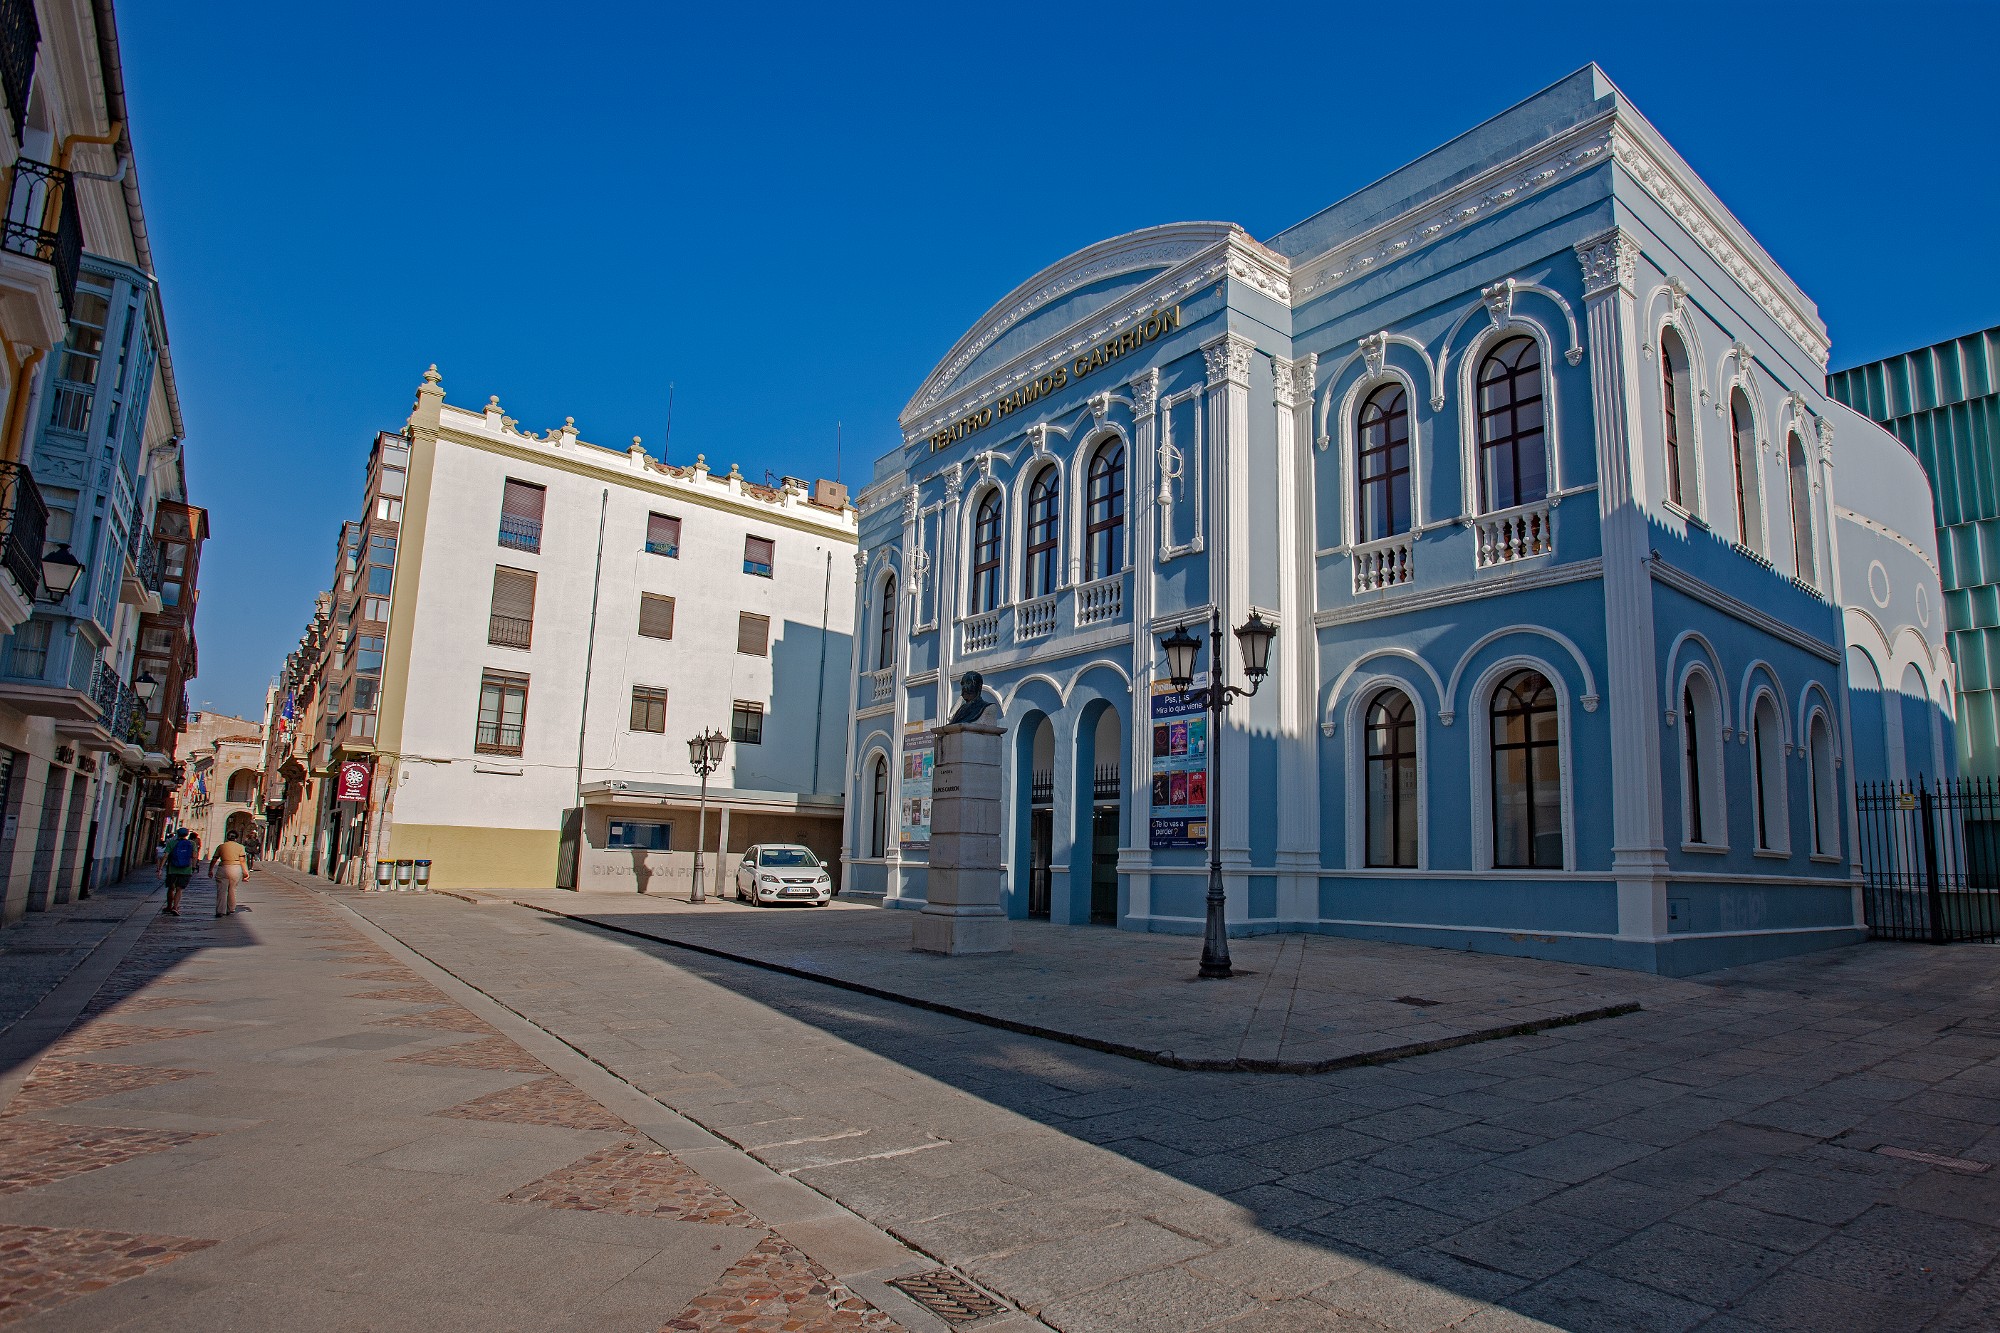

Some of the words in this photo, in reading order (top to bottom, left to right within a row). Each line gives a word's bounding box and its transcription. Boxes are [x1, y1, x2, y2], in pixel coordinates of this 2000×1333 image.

[928, 408, 992, 453] TEATRO
[997, 367, 1067, 418] RAMOS
[1073, 305, 1181, 378] CARRIÓN
[1156, 706, 1168, 714] Mira
[1174, 705, 1186, 713] que
[1163, 820, 1169, 828] lo
